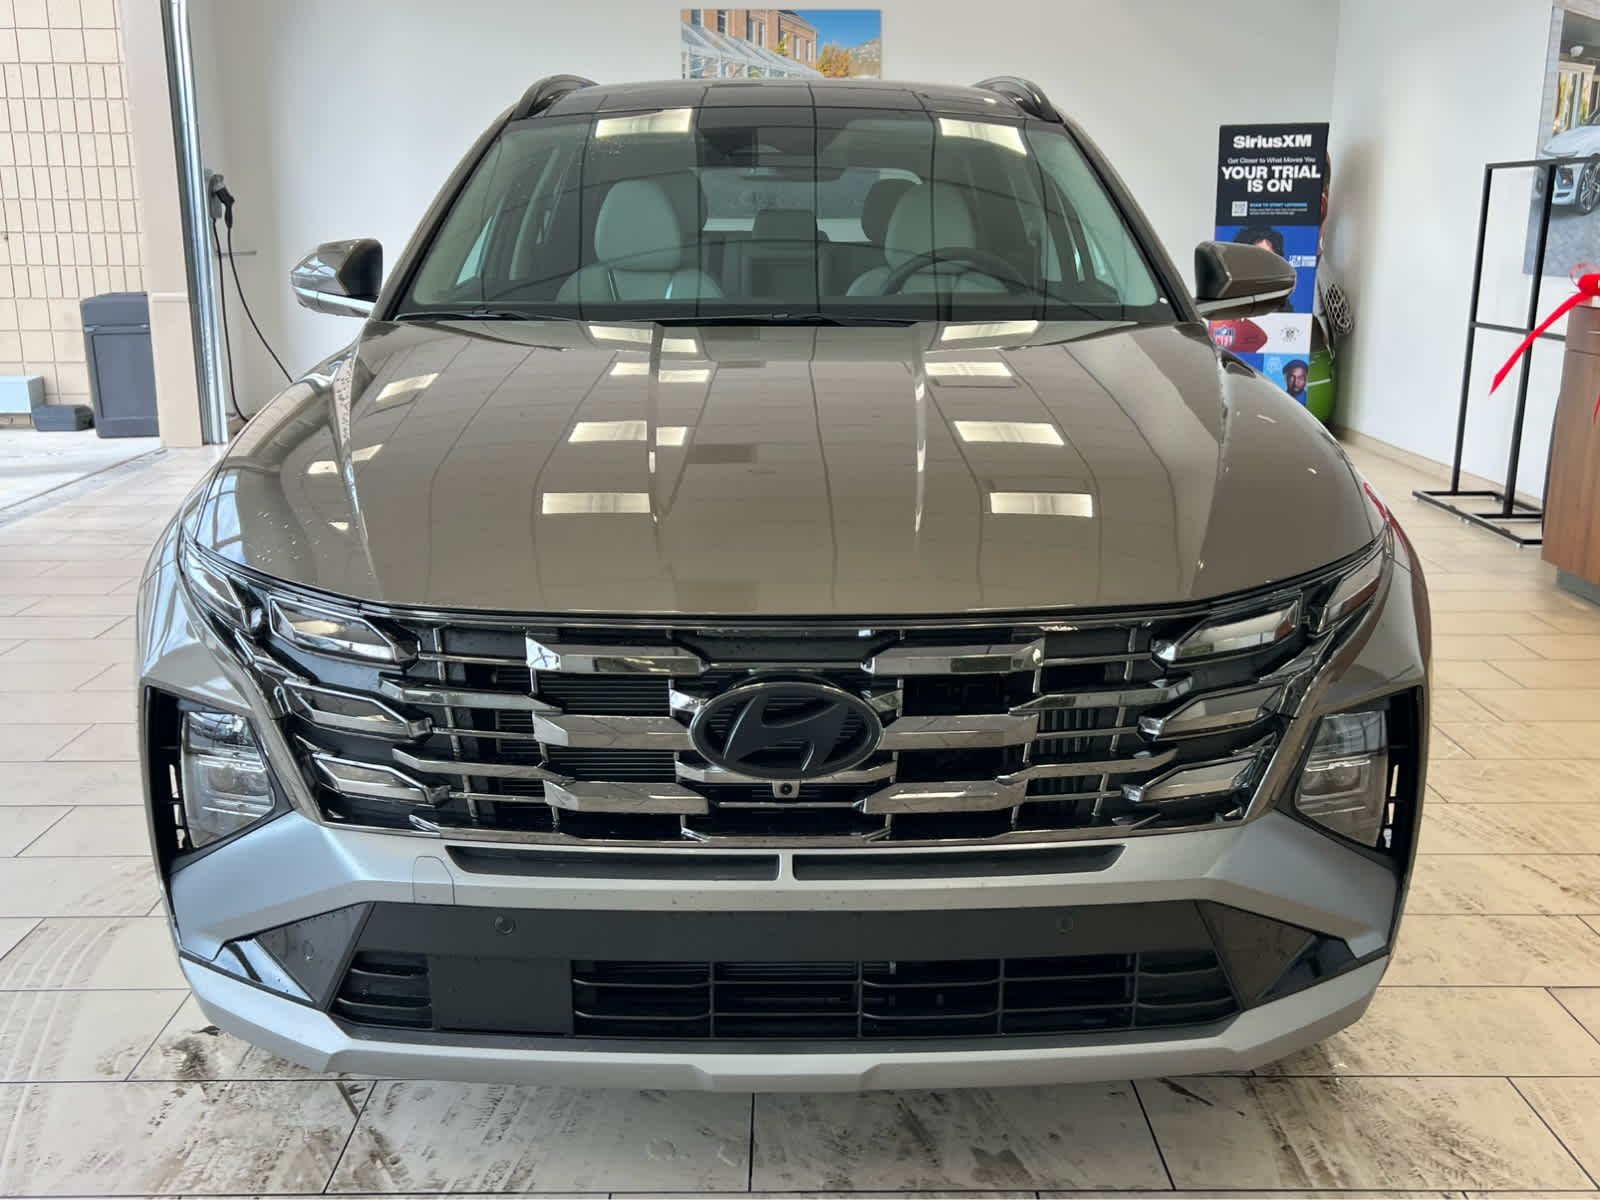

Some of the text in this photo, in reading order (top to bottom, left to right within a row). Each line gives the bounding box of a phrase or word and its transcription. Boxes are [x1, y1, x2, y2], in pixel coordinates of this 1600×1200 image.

[1232, 134, 1312, 148] SiriusXM
[1221, 164, 1320, 180] YOUR TRIAL
[1247, 179, 1293, 192] IS ON
